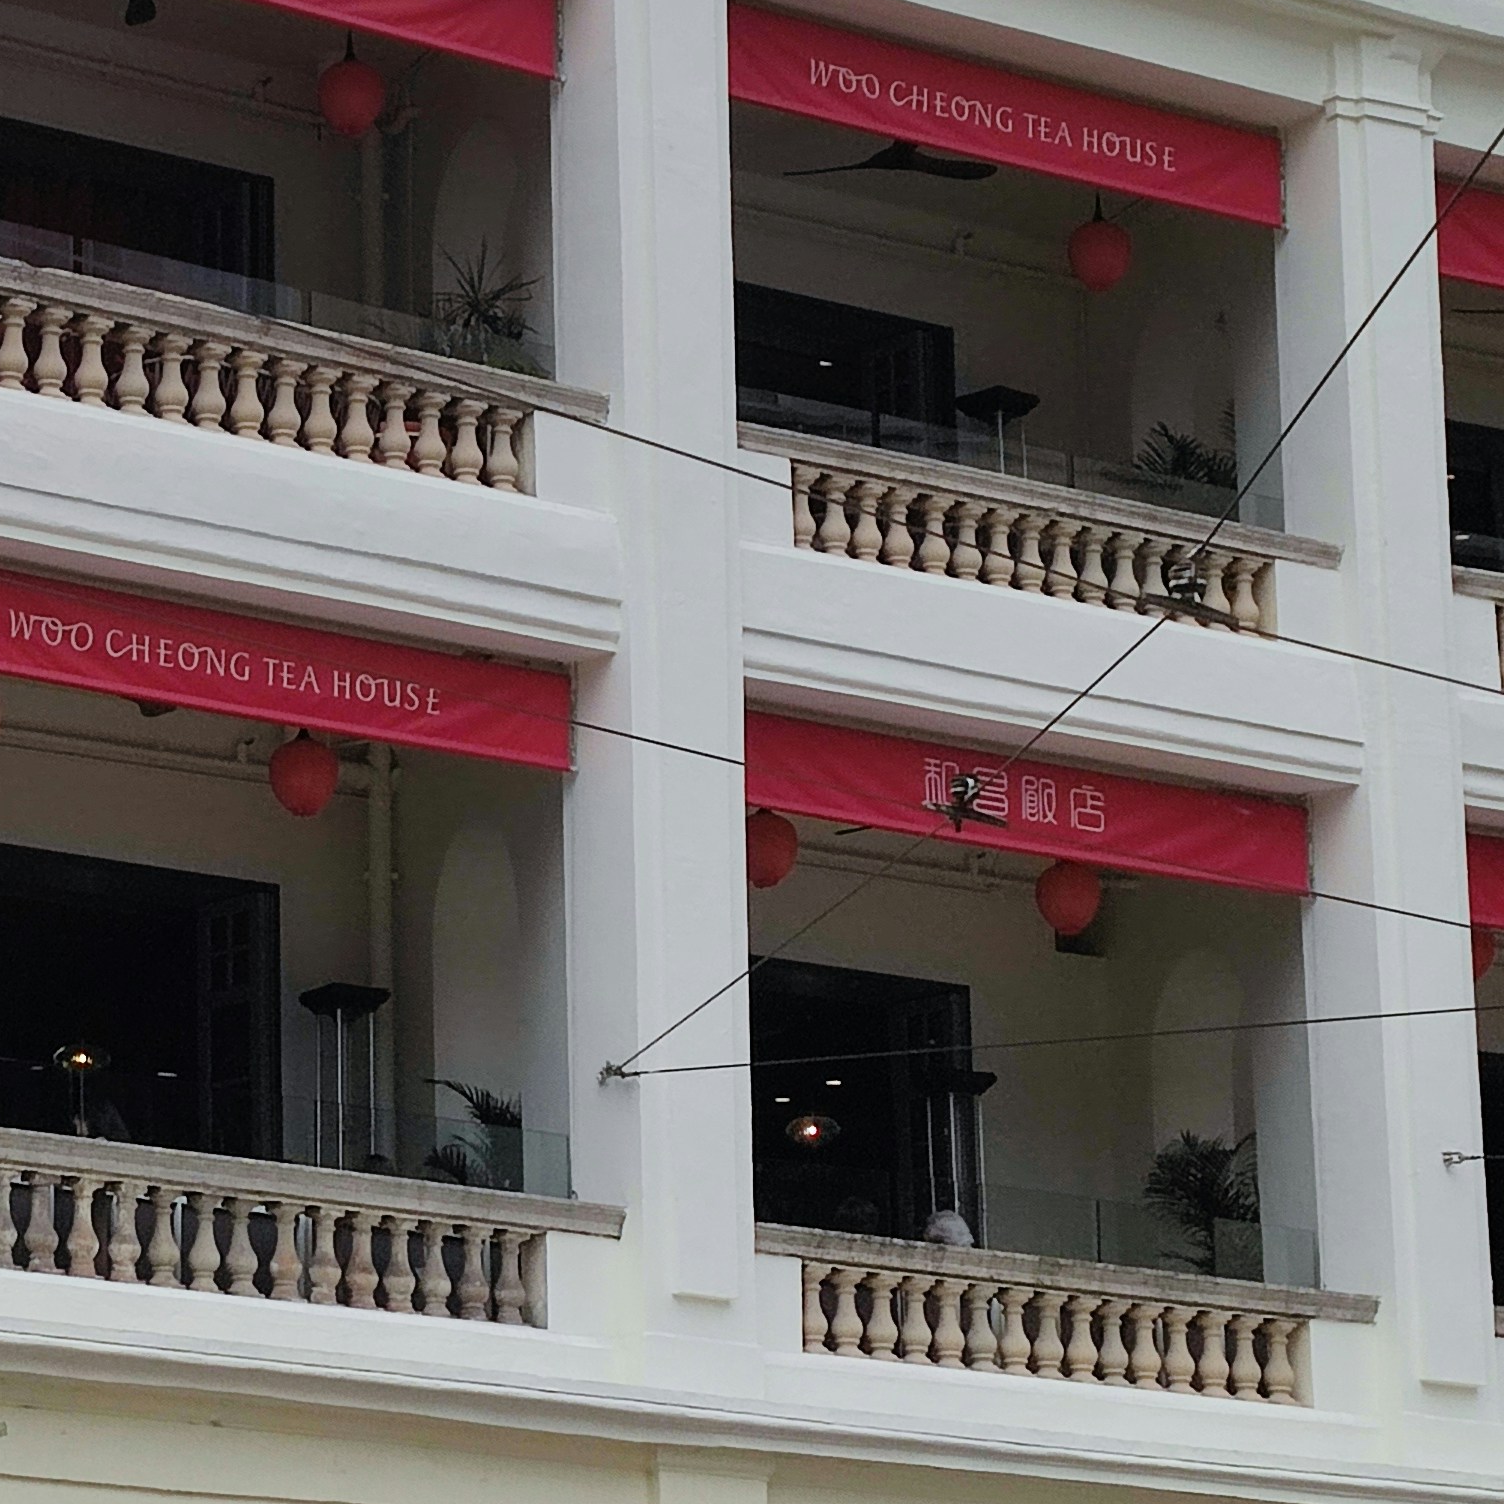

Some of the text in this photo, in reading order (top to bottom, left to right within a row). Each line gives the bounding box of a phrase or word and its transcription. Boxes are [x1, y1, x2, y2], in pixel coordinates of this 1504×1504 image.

[808, 57, 1177, 172] WOO CHEONG TEA HOUSE
[7, 608, 442, 716] WOO CHEONG TEA HOUSE
